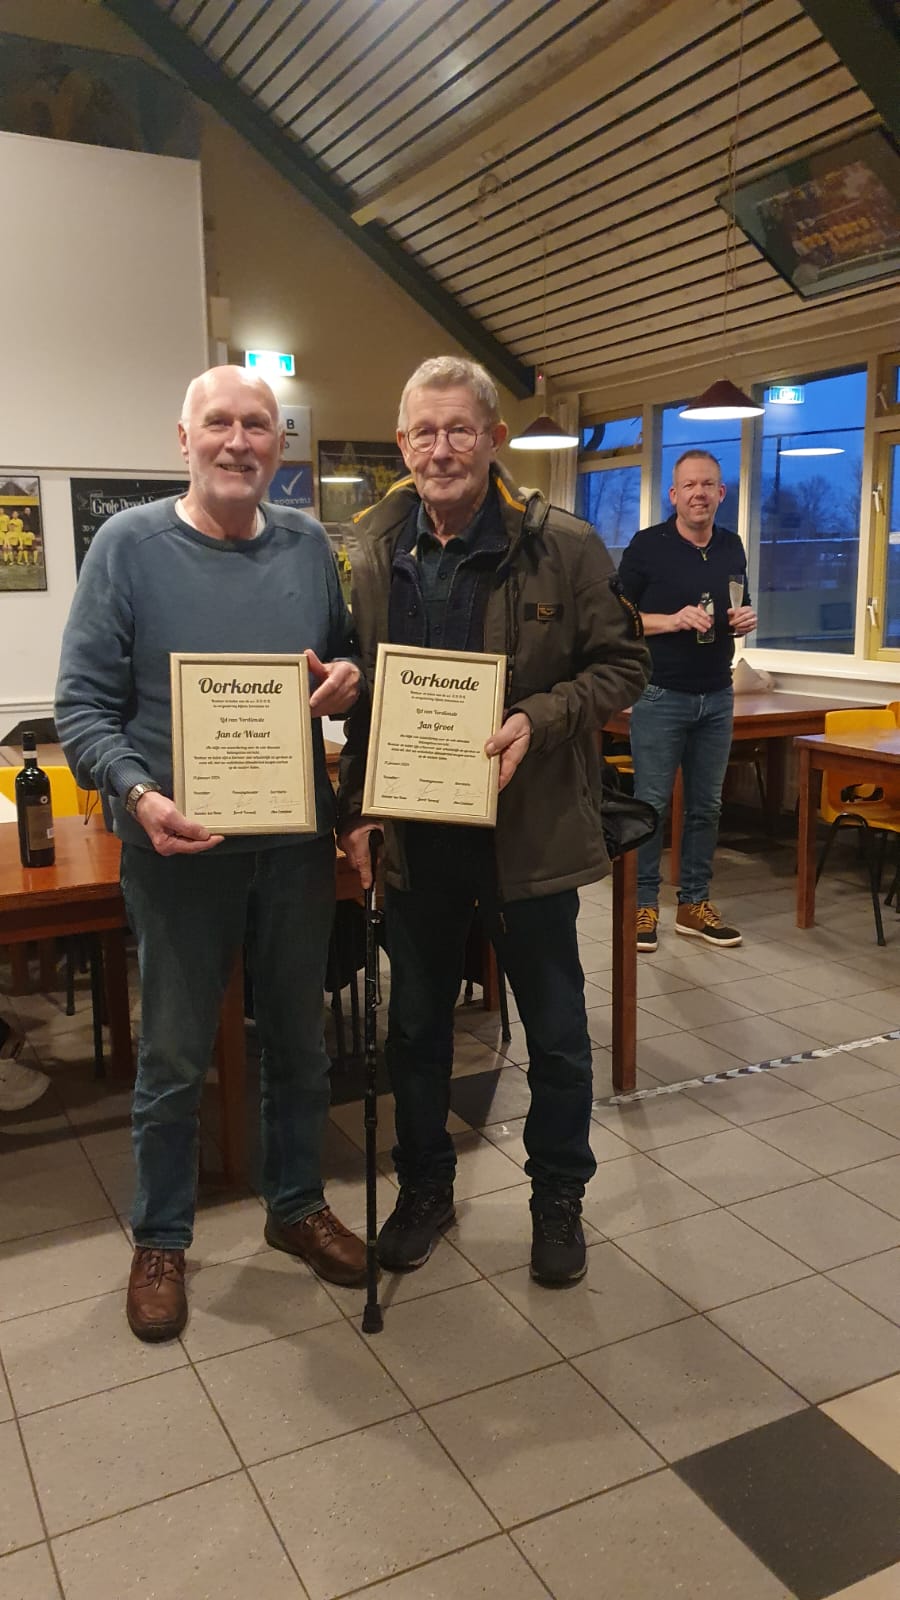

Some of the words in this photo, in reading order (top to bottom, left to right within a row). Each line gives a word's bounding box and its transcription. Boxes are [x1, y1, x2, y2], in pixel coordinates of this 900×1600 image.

[198, 677, 284, 695] Oorkonde
[400, 669, 480, 692] Oorkonde
[417, 720, 432, 730] Jan
[433, 721, 454, 732] Groot
[215, 730, 231, 741] Jan
[232, 730, 242, 739] de
[243, 729, 271, 739] Waart
